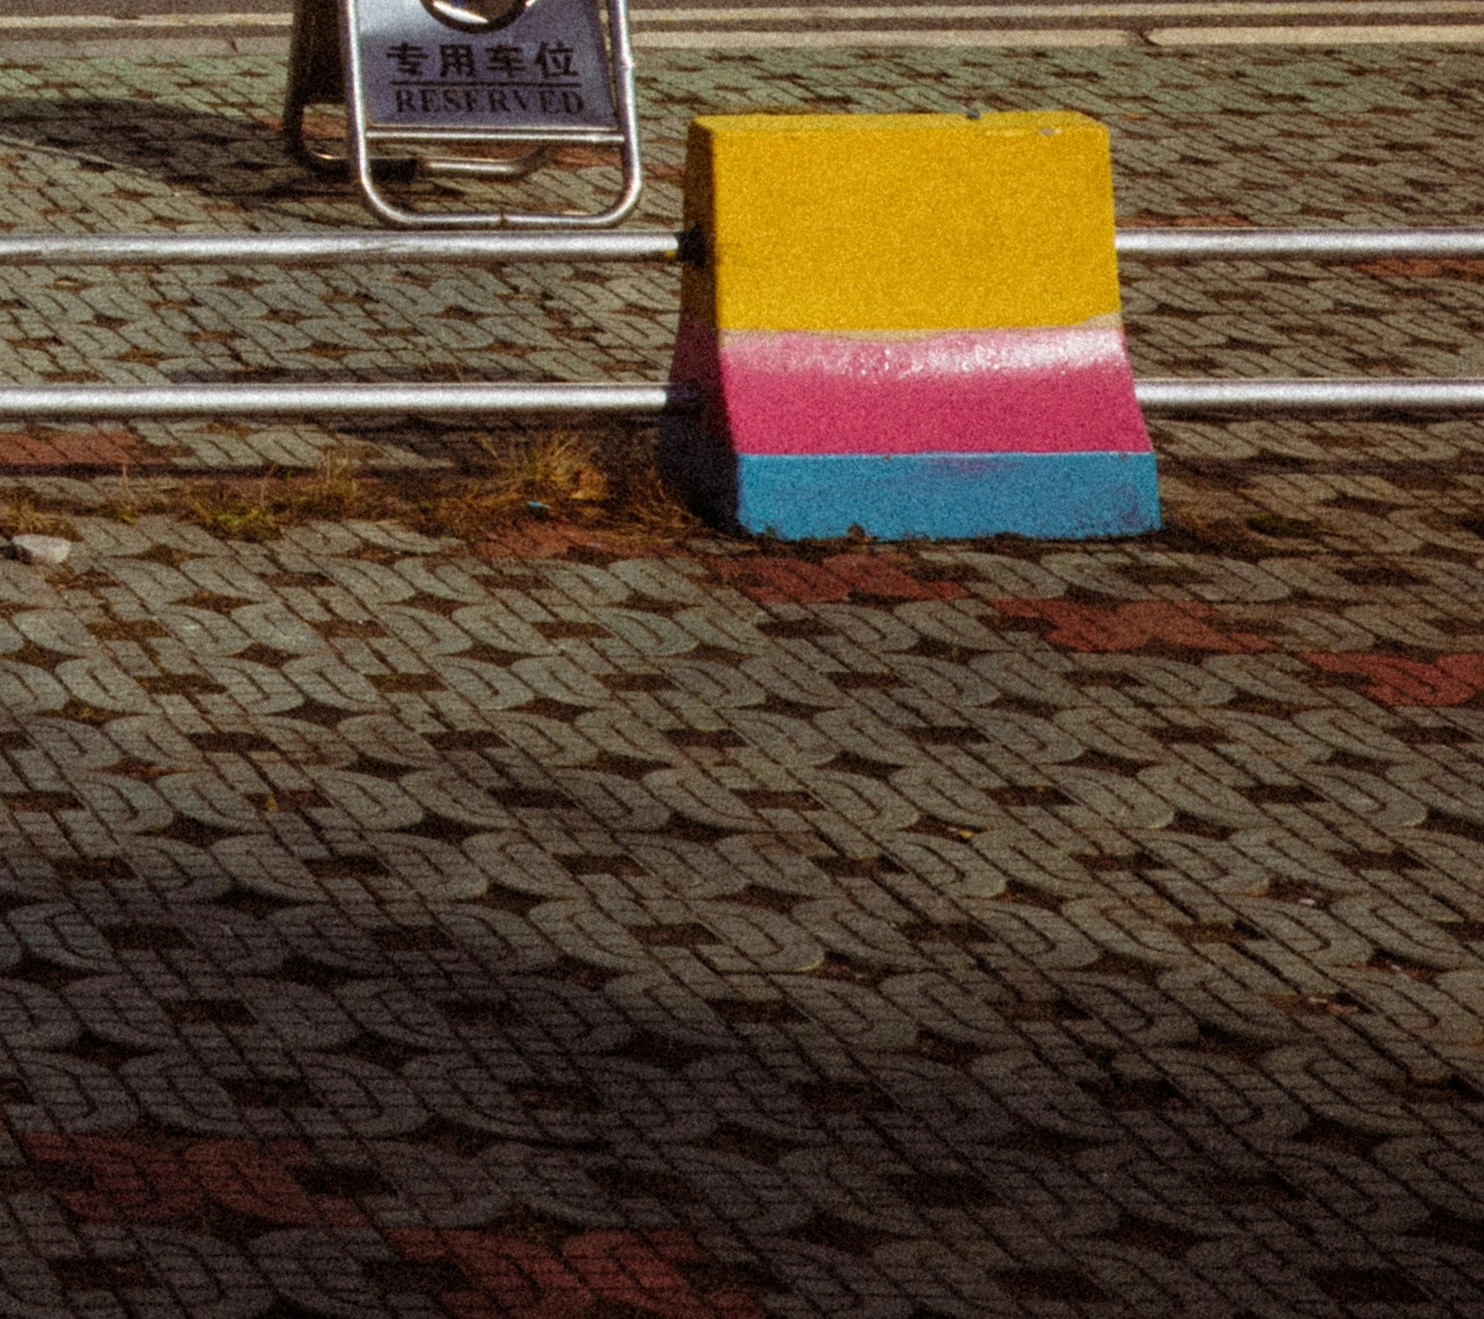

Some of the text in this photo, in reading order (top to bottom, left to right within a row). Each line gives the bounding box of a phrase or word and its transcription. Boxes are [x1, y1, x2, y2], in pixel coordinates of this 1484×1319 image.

[386, 41, 579, 78] 专用车位
[396, 89, 584, 113] RESERVED
